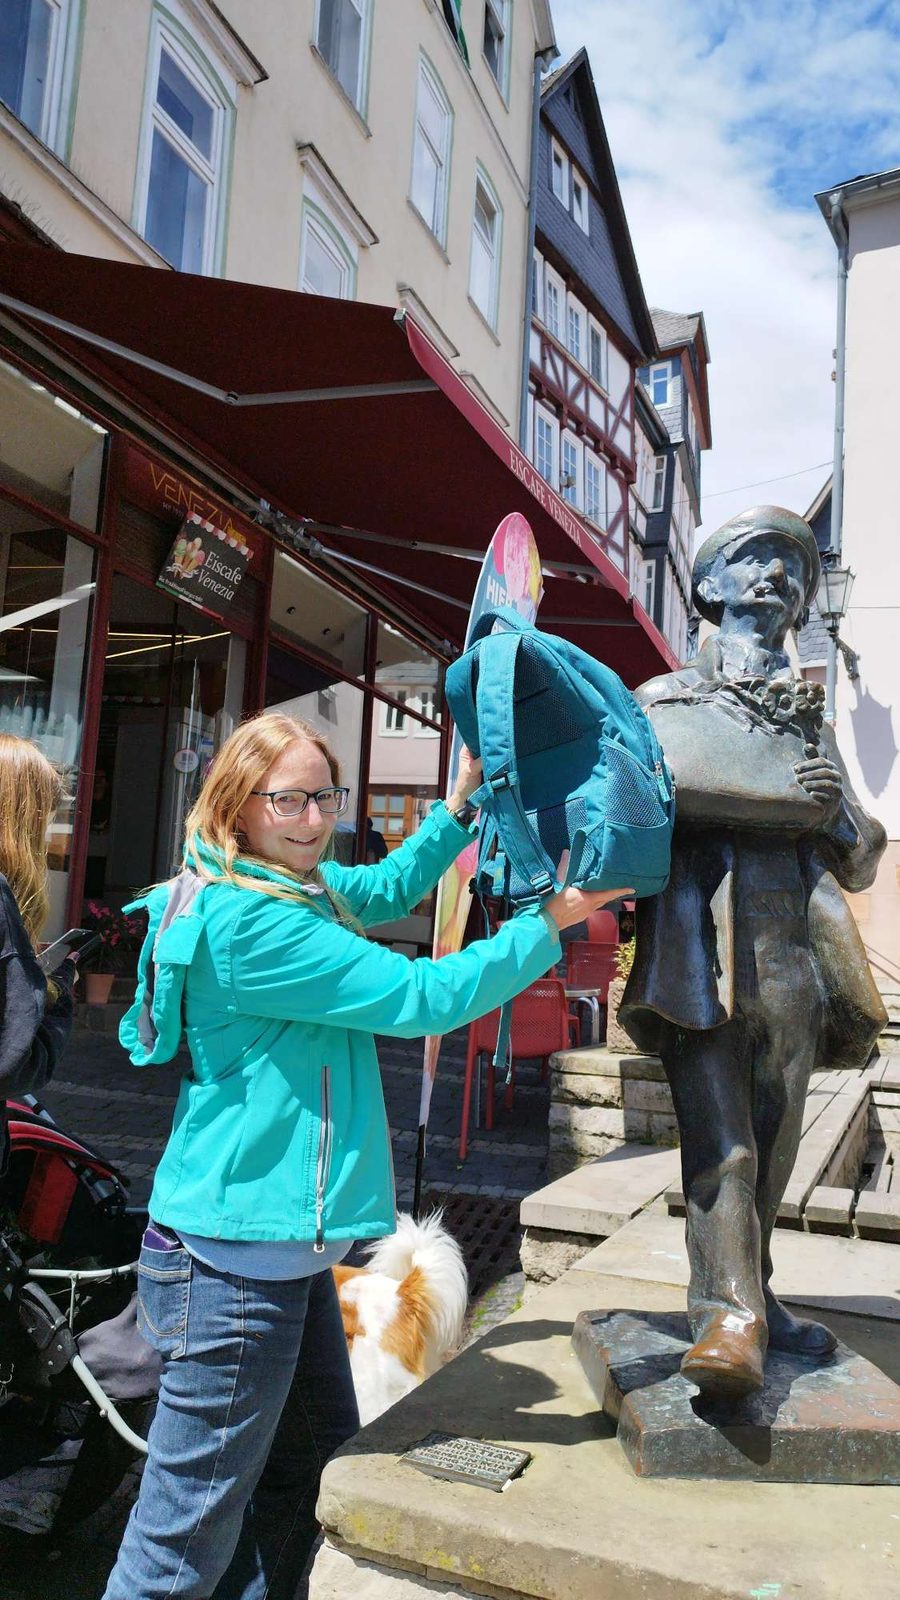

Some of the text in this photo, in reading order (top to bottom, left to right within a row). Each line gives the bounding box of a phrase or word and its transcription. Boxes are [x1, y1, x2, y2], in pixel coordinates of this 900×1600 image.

[509, 448, 582, 547] EISCAFE VENEZIA
[197, 568, 235, 602] Venezia
[204, 551, 242, 585] Eiscafe
